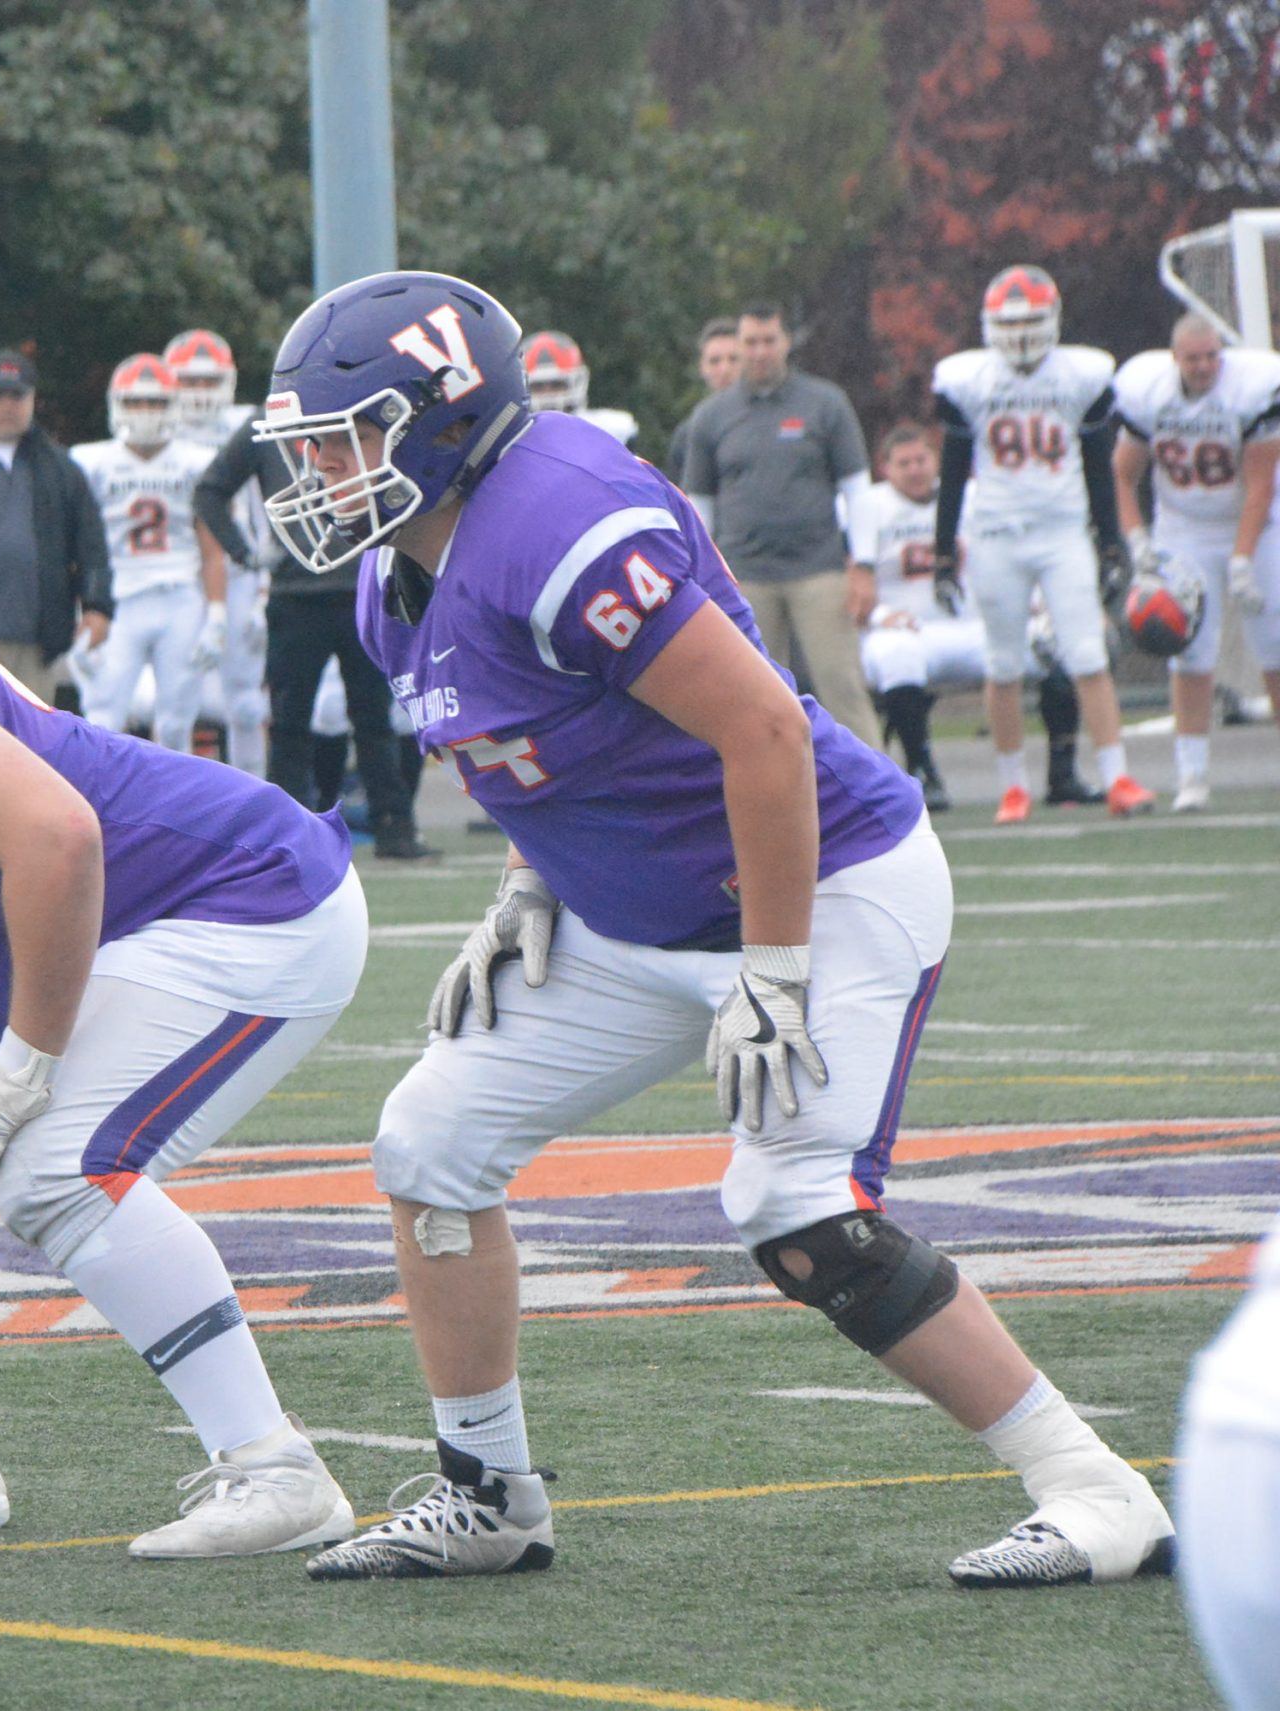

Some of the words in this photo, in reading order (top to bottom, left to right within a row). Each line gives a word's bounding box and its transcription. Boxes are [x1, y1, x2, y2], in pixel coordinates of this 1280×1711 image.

[389, 303, 485, 404] V
[987, 413, 1068, 475] 84
[128, 496, 168, 556] 2
[583, 550, 674, 652] 64
